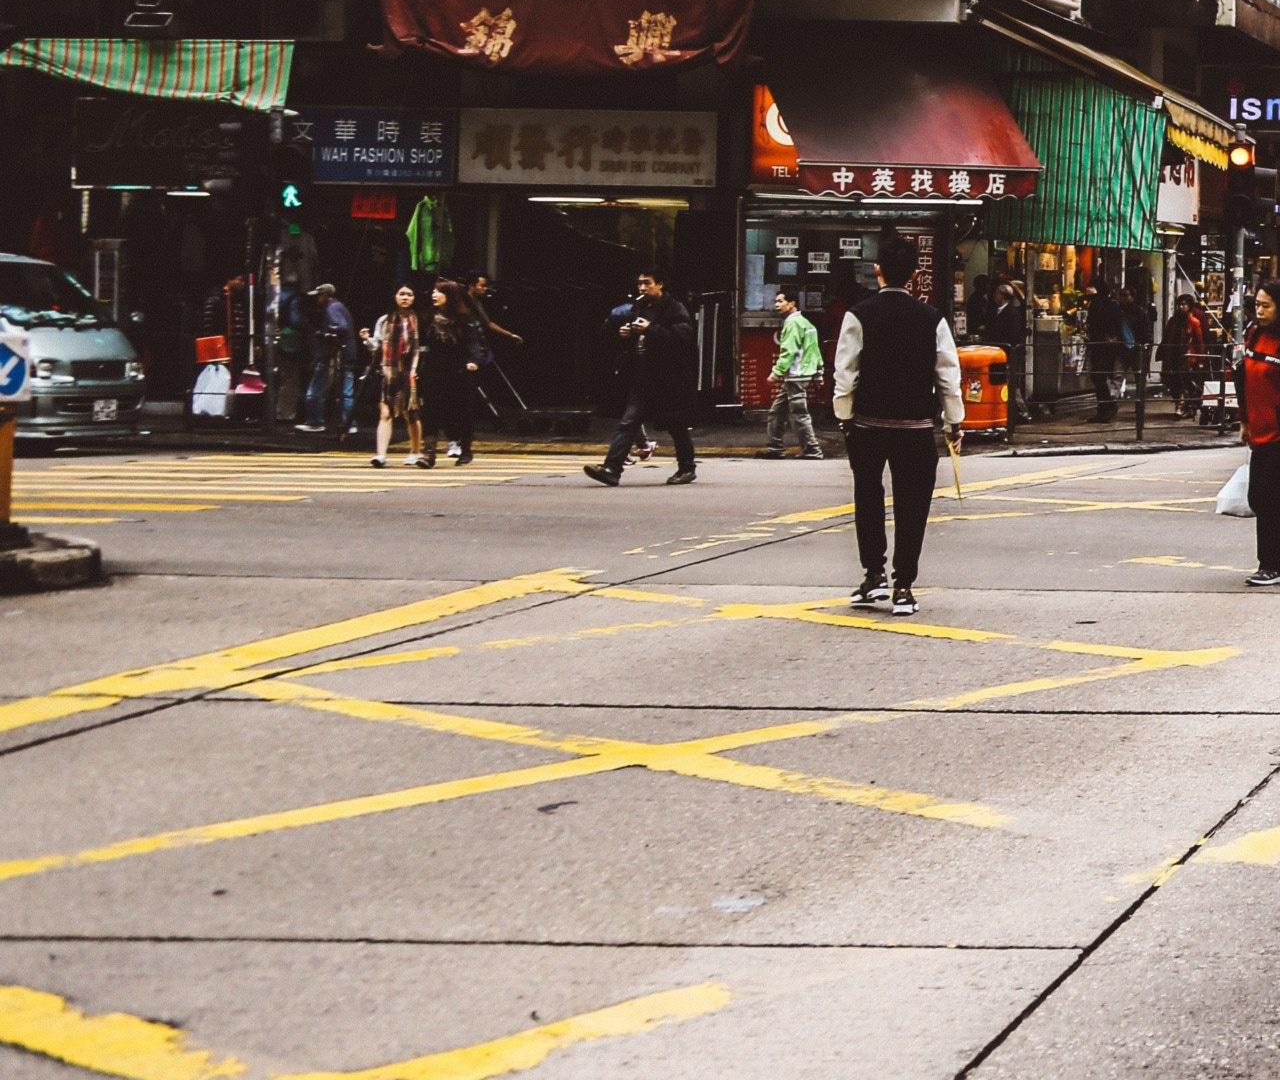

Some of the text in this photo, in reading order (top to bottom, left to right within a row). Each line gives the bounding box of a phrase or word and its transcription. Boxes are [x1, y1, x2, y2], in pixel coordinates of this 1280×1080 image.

[321, 148, 442, 164] WAH FASHION SHOP
[772, 166, 790, 178] TEL
[832, 167, 1006, 195] 中英找換店
